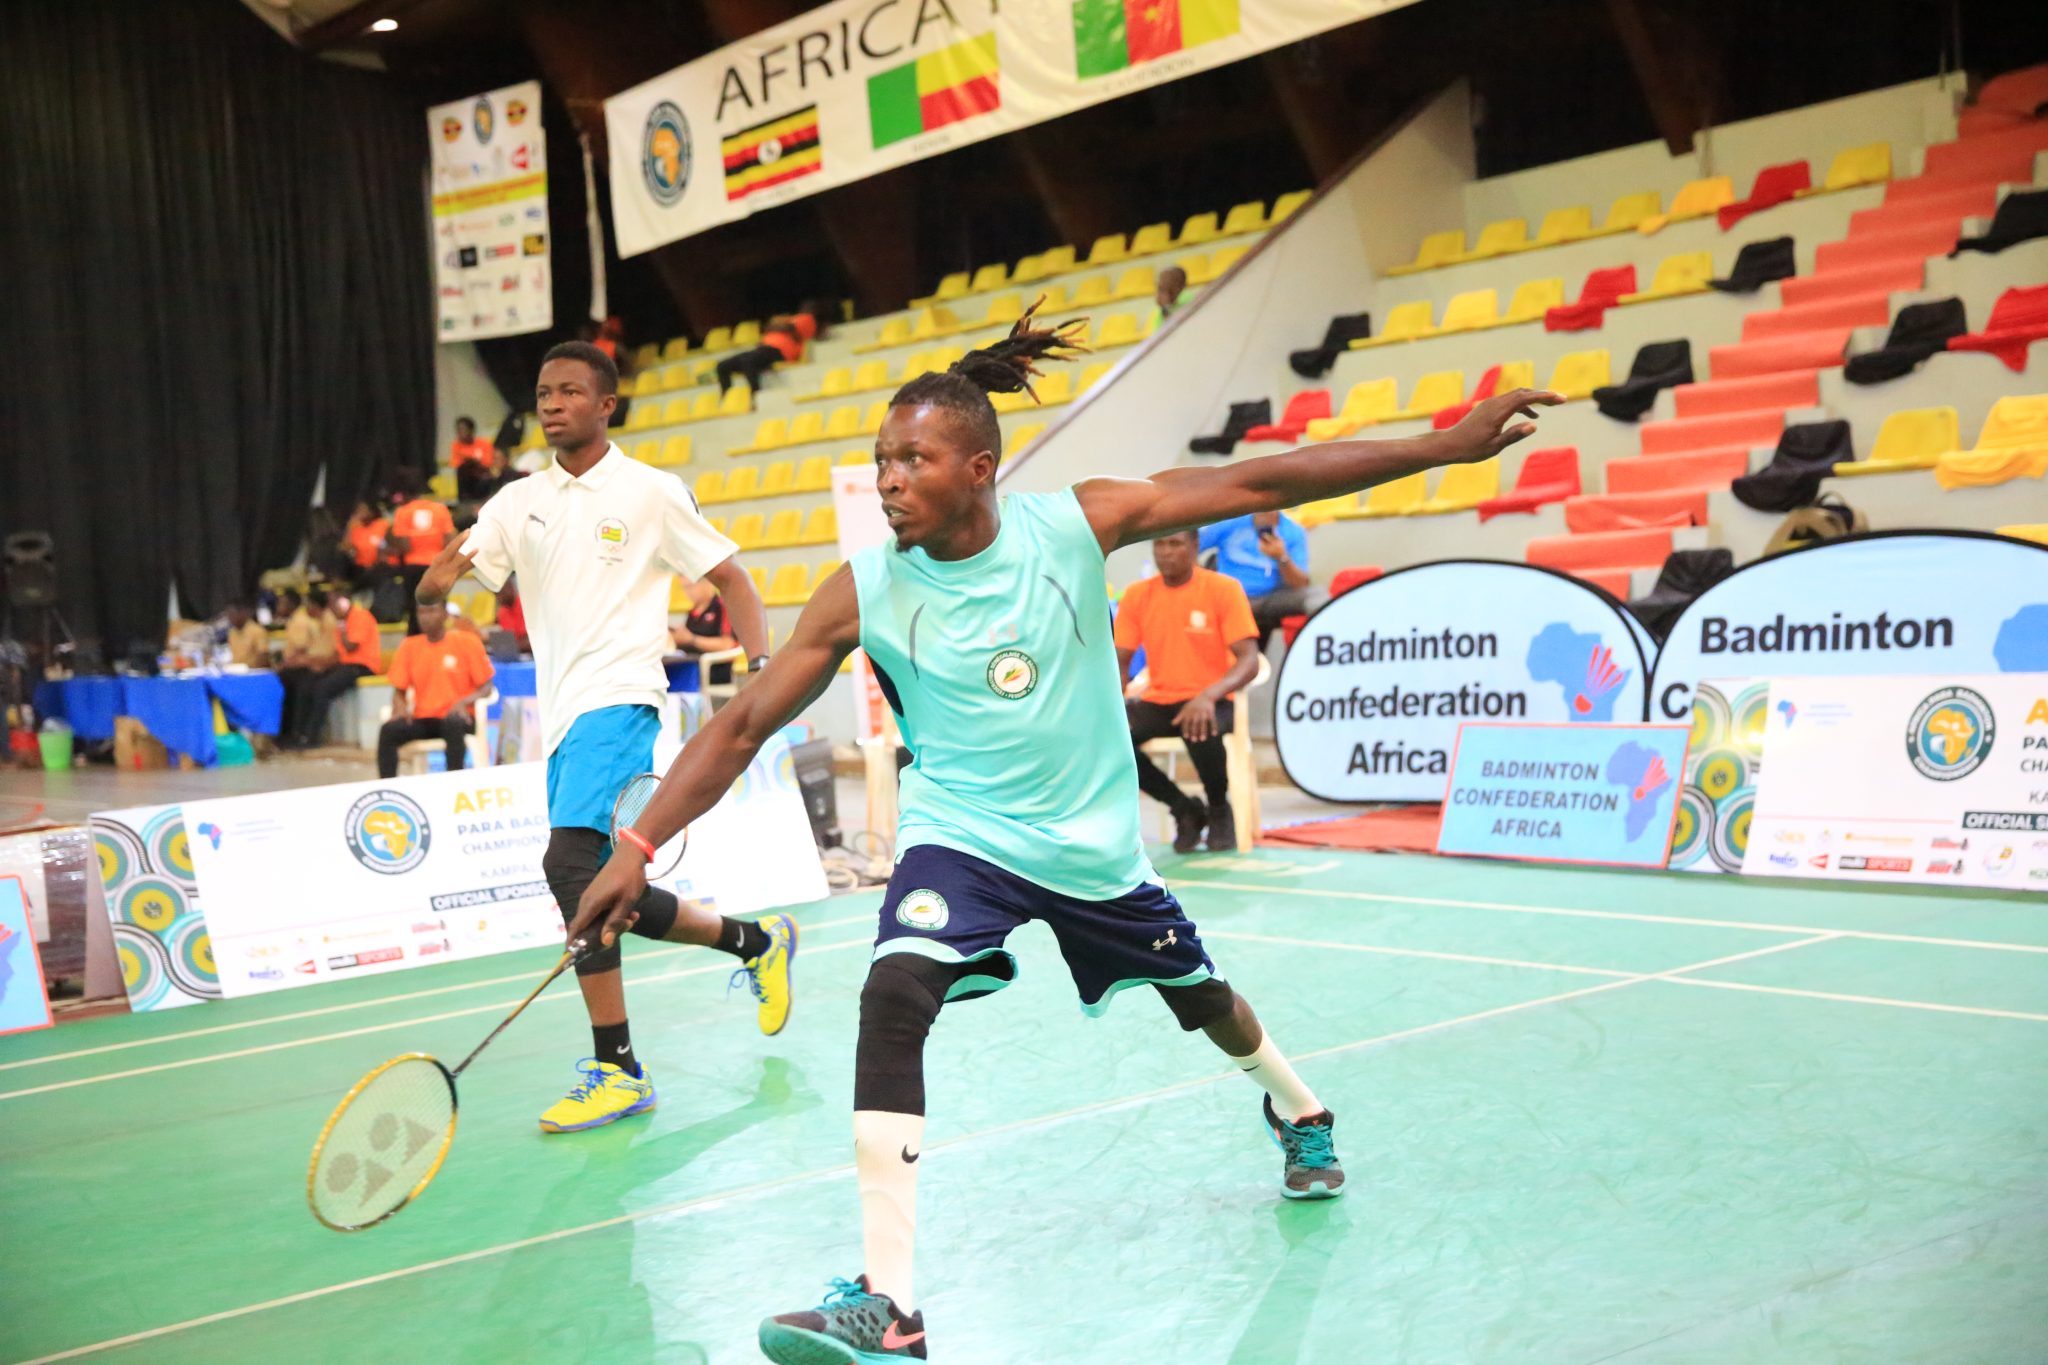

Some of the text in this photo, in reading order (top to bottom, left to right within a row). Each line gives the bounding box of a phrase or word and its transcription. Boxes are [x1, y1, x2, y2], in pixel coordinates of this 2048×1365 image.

[715, 0, 961, 122] AFRICA
[1700, 610, 1954, 654] Badminton
[1314, 627, 1498, 667] Badminton
[1286, 681, 1526, 722] Confederation
[1661, 683, 1696, 719] C
[1347, 741, 1447, 775] Africa
[2020, 758, 2048, 773] CH
[1481, 760, 1599, 781] BADMINTON
[1453, 787, 1618, 812] CONFEDERATION
[457, 814, 547, 836] PARA BAD
[1490, 818, 1562, 839] AFRICA
[1964, 813, 2048, 830] OFFICIAL S
[480, 862, 542, 880] KAMPAL
[433, 890, 493, 911] OFFICIAL
